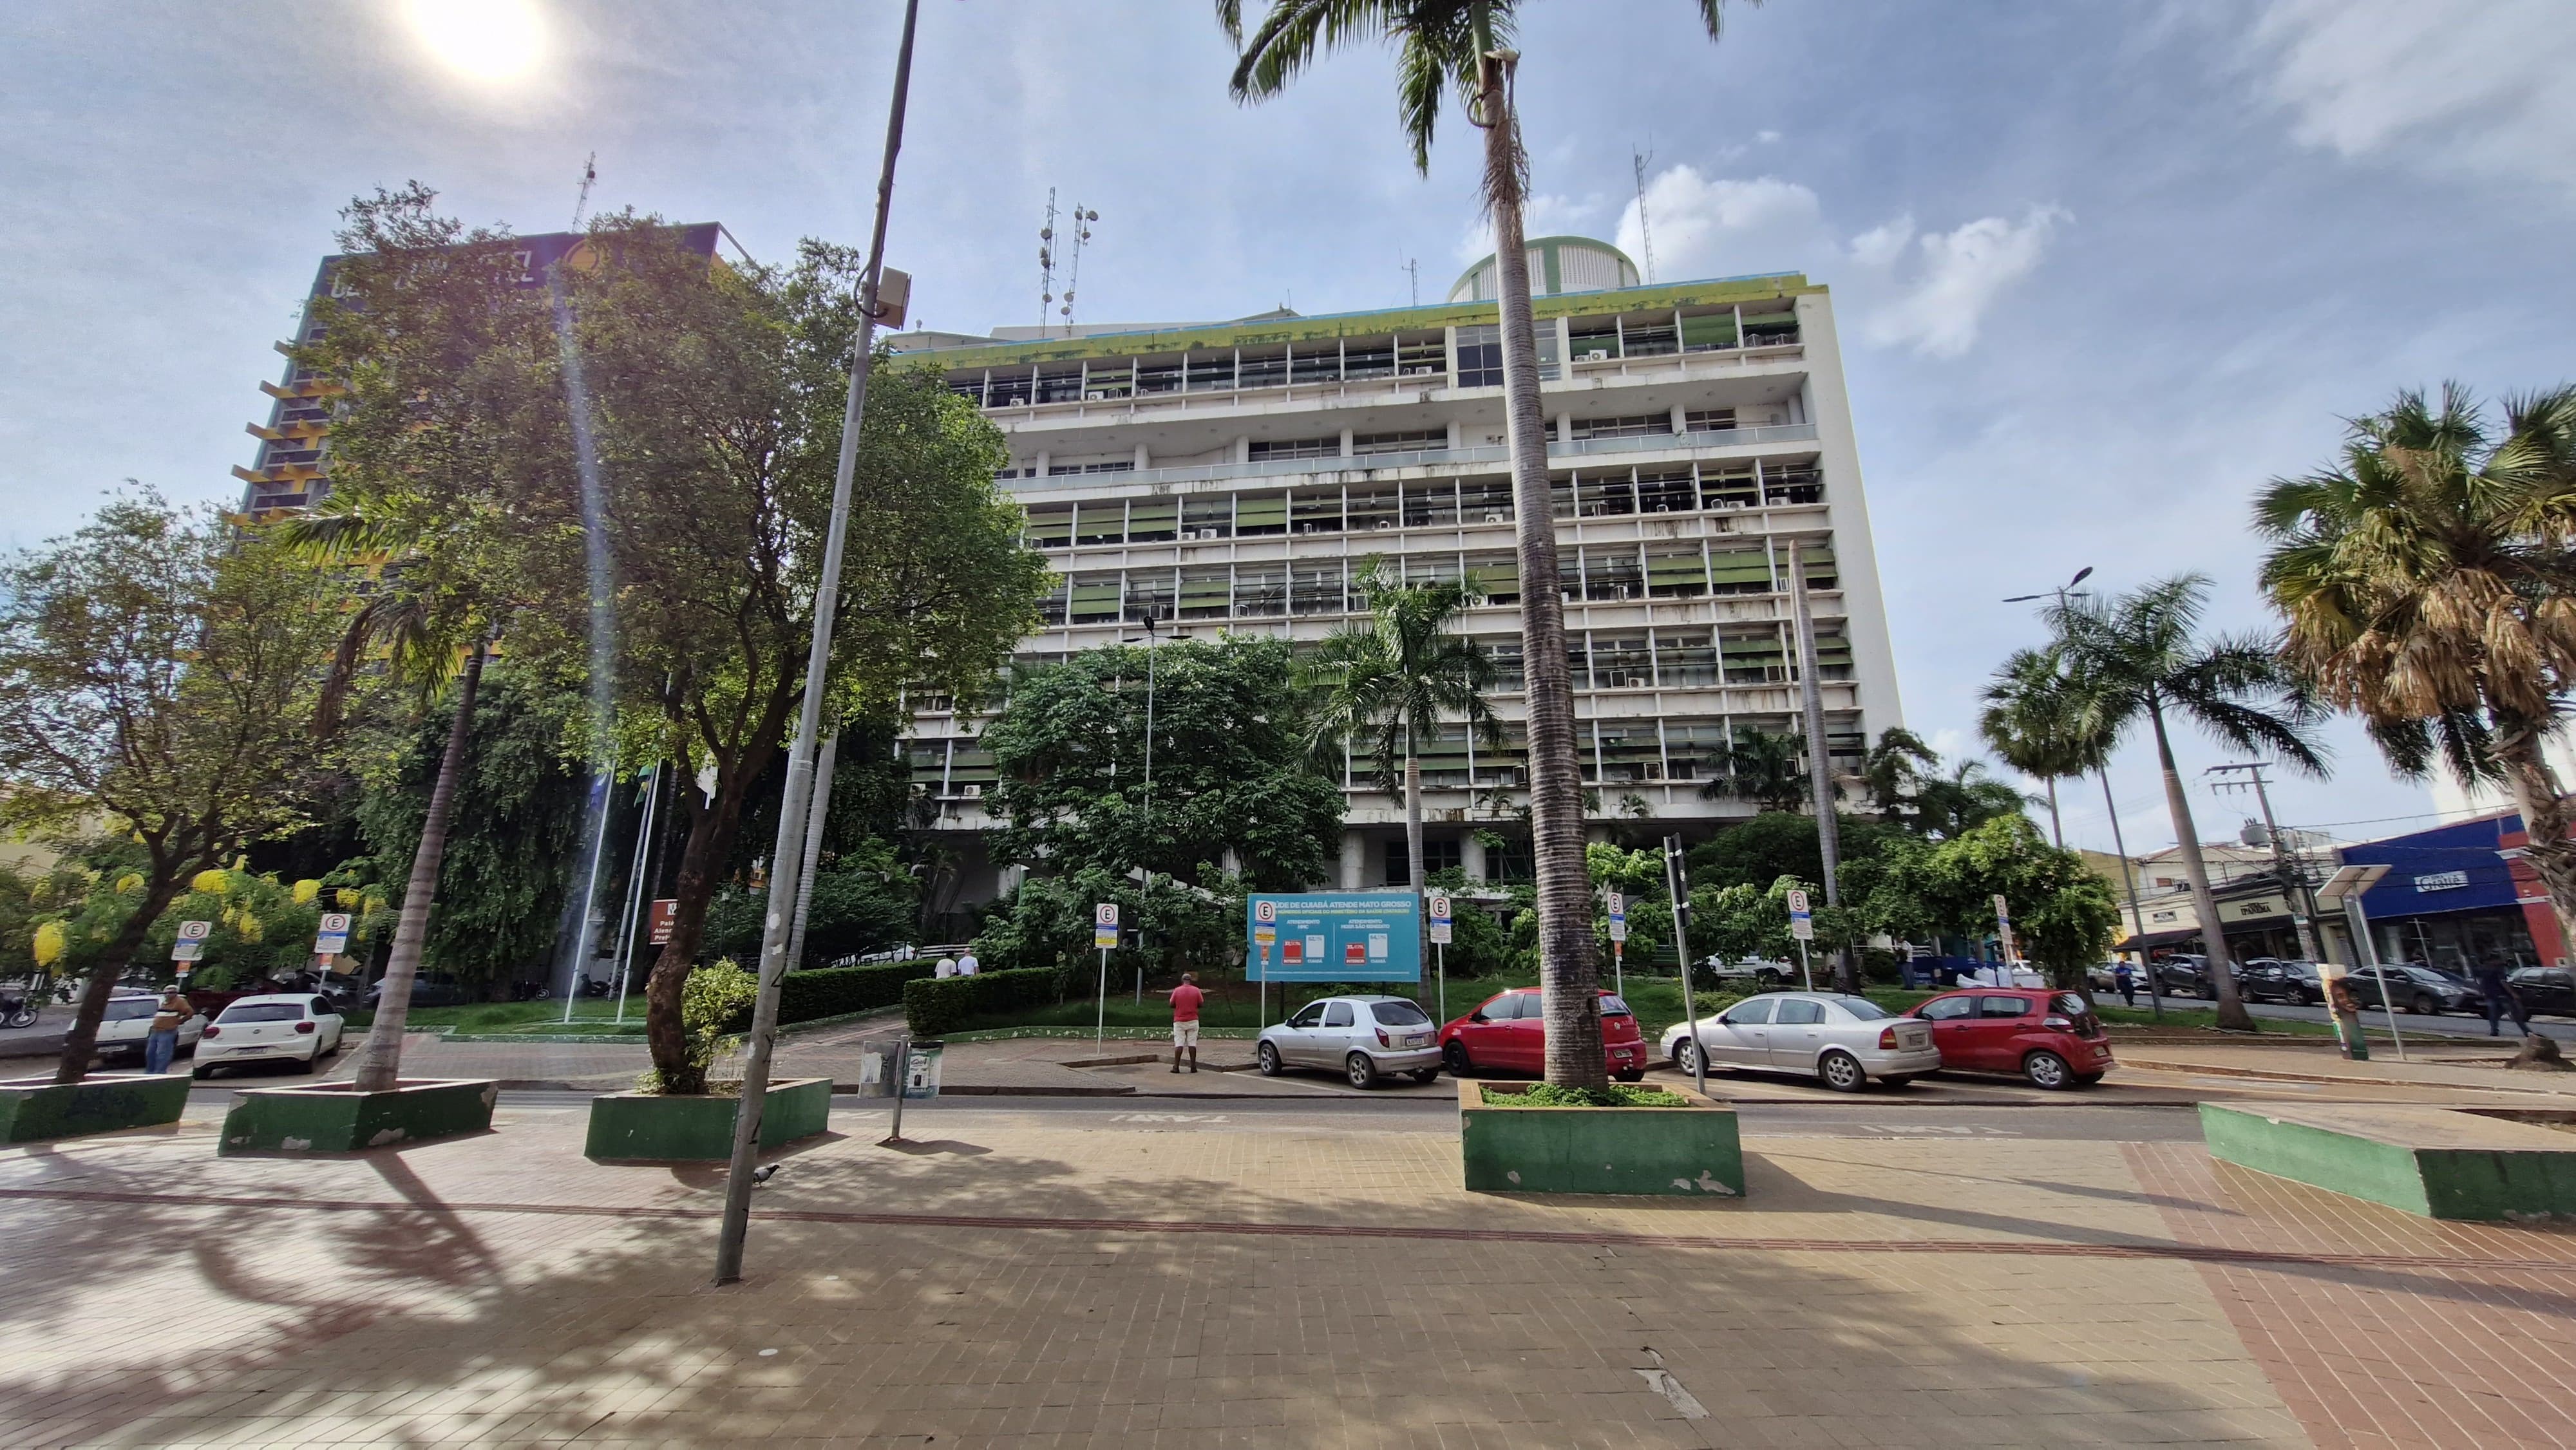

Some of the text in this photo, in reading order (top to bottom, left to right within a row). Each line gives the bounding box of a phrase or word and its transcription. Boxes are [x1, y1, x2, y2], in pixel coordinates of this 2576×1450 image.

[1275, 899, 1289, 909] ÚDE
[1301, 900, 1328, 909] CUIABÁ
[1613, 898, 1618, 909] E
[1795, 895, 1801, 907] E
[1263, 906, 1268, 916] E
[1437, 901, 1443, 912] E
[1105, 909, 1111, 919] E
[331, 918, 341, 927] E
[190, 925, 201, 935] E
